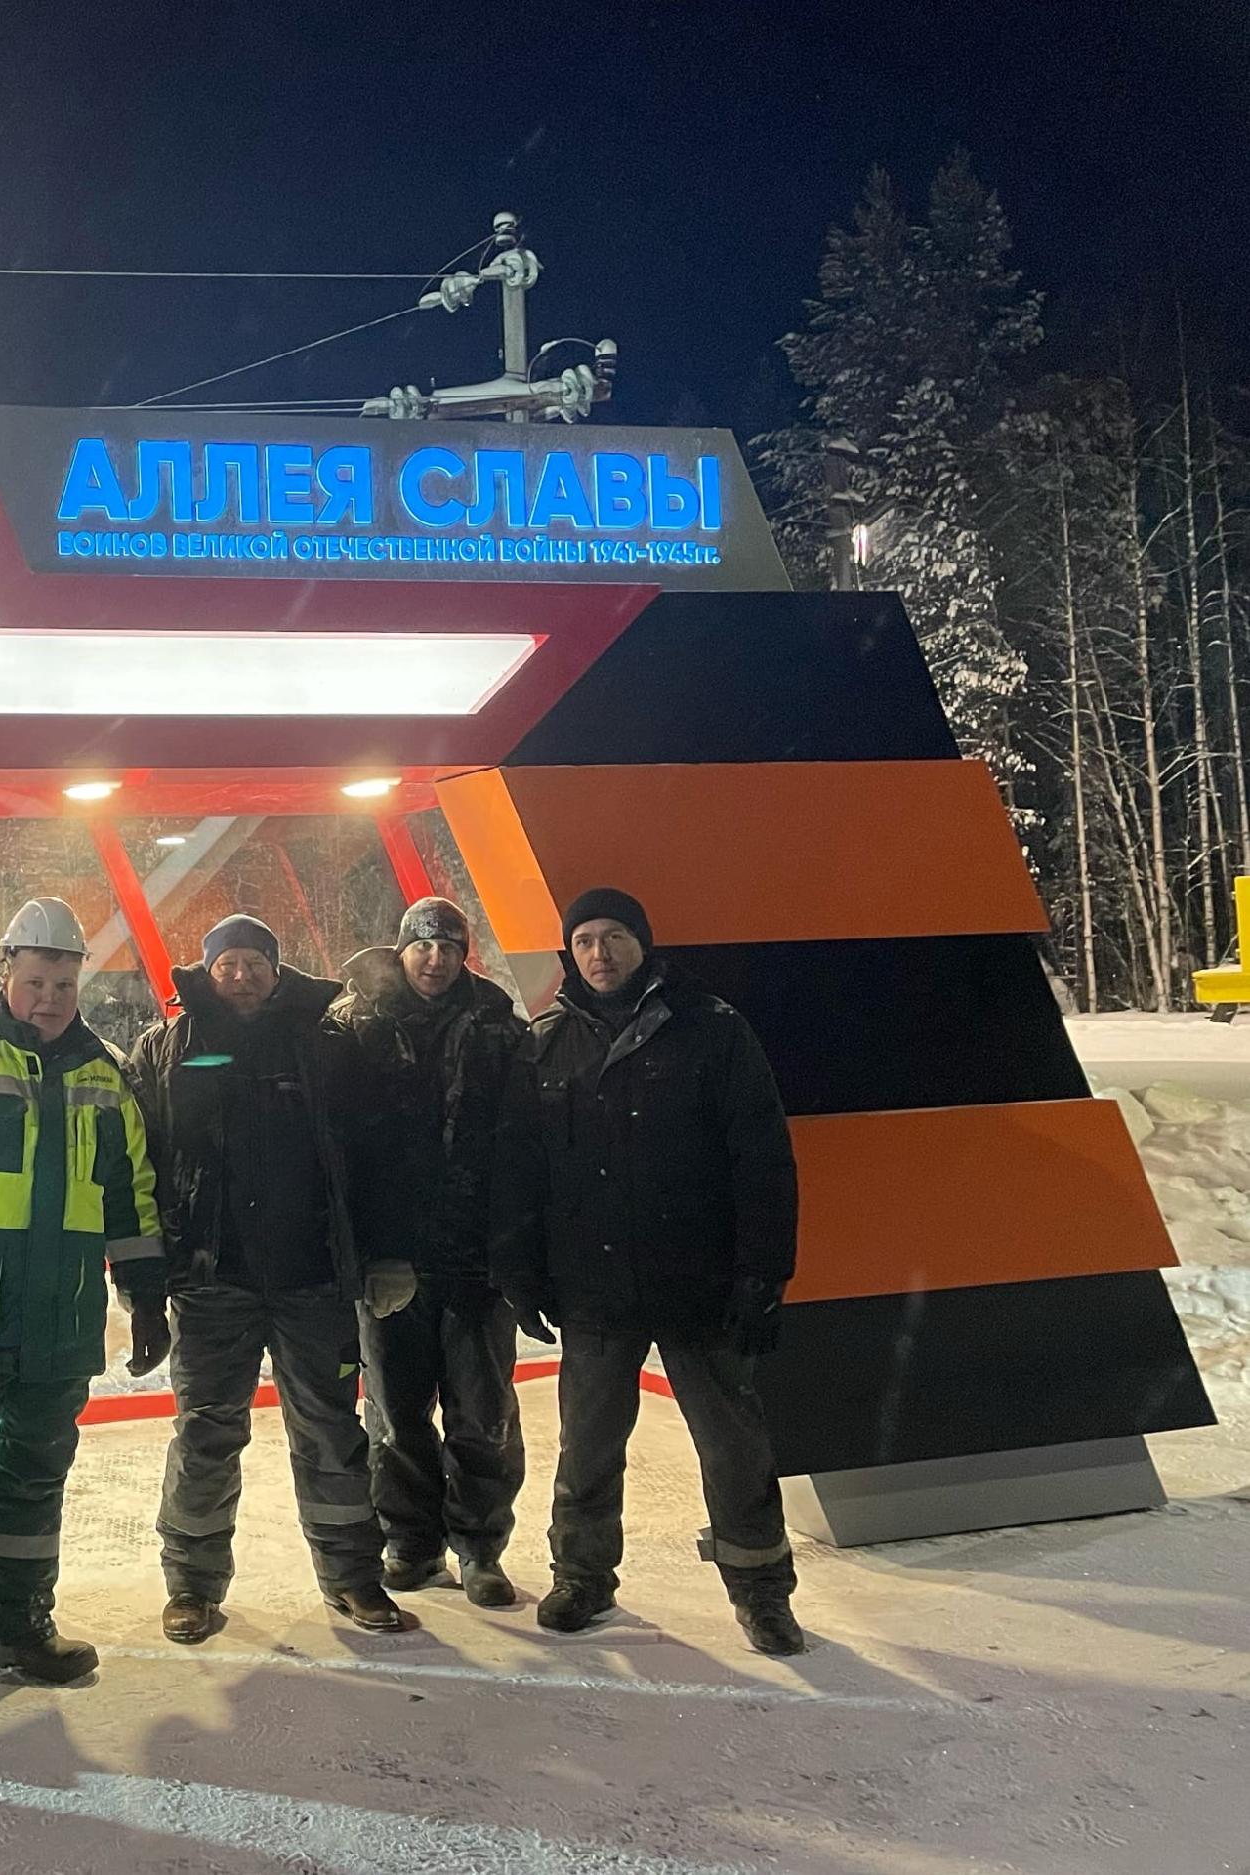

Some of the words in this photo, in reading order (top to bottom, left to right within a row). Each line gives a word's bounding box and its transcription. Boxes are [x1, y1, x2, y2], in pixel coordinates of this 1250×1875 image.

[57, 438, 373, 524] АЛЛЕЯ
[399, 446, 722, 530] СЛАВЫ
[57, 531, 168, 558] ВОИНОВ
[172, 531, 290, 560] ВЕЛИКОЙ
[292, 533, 496, 562] ОТЕЧЕСТВЕННОЙ
[499, 534, 587, 563] ВОЙНЫ
